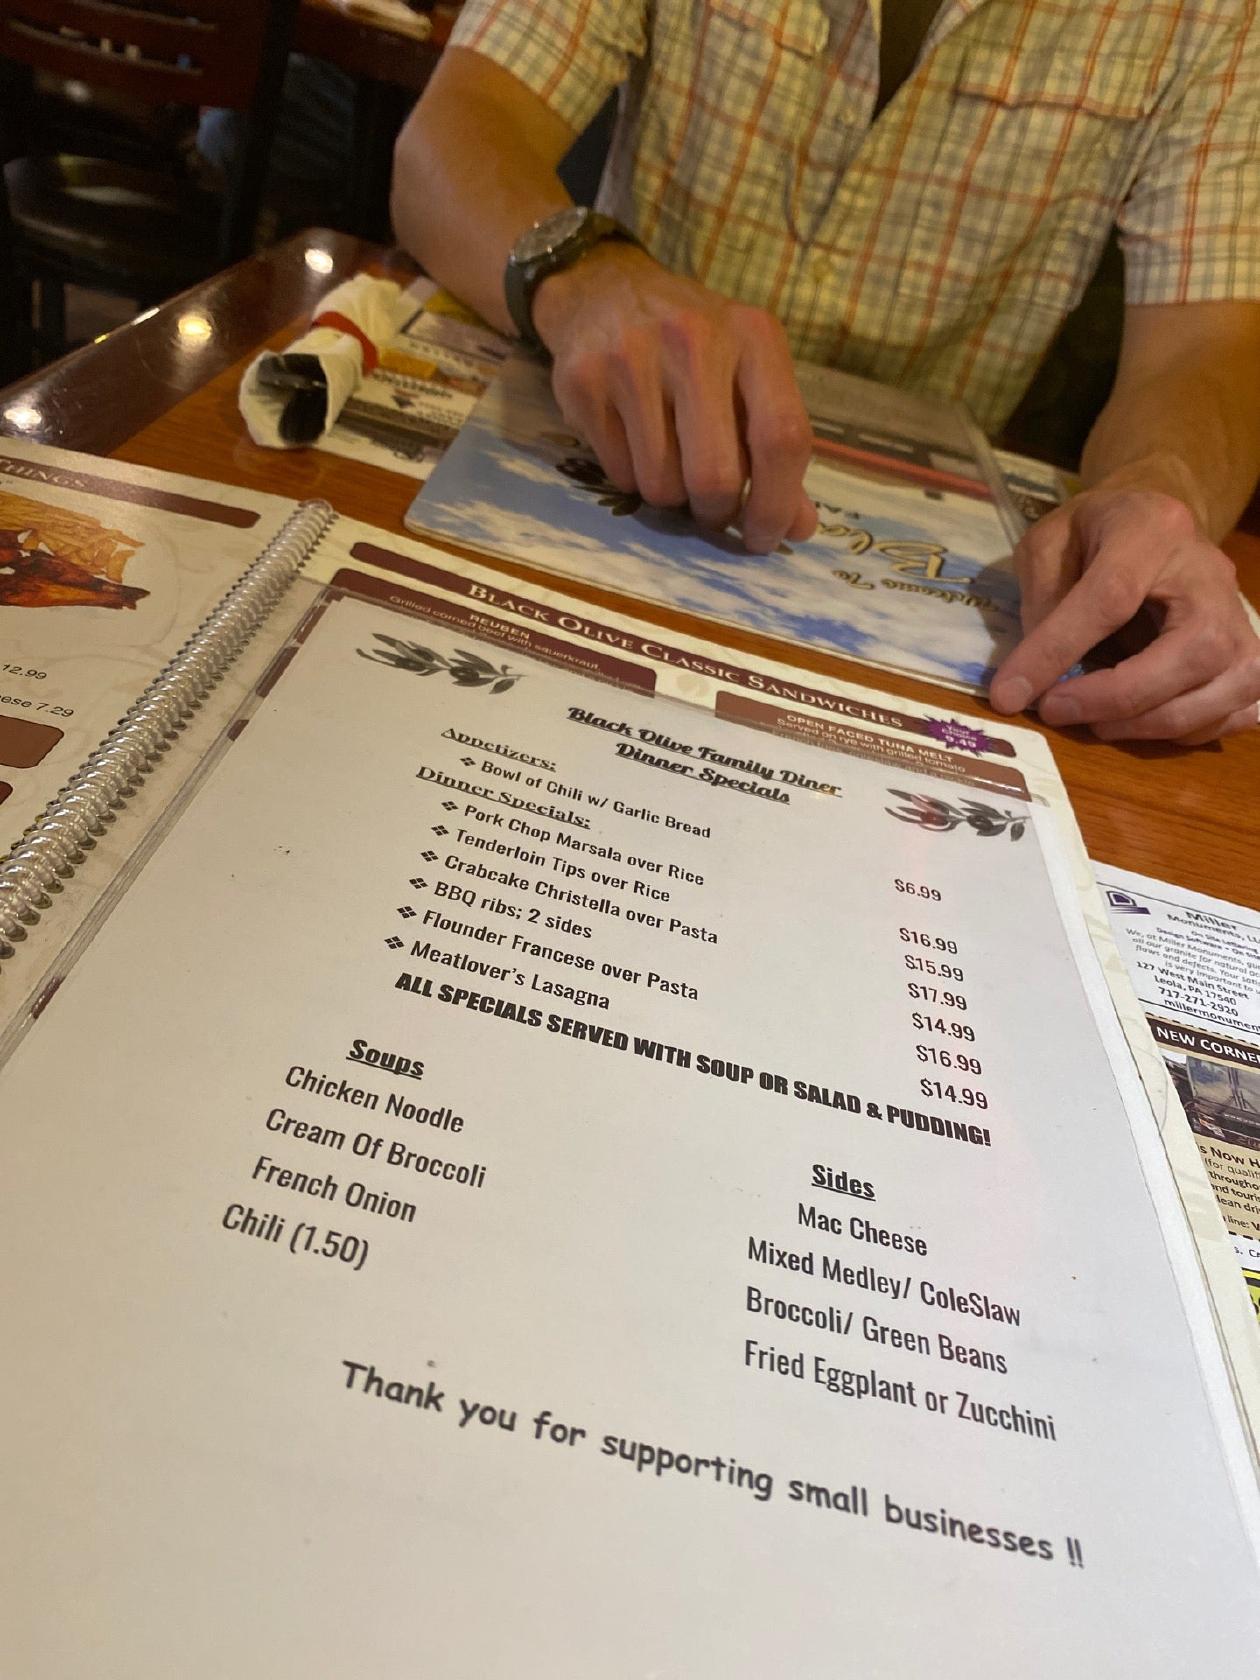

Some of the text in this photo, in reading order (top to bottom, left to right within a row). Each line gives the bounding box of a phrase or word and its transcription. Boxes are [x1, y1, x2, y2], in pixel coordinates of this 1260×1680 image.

[469, 584, 550, 622] BLACK
[558, 617, 634, 650] OLIVE
[641, 643, 740, 683] CLASSIC
[748, 674, 904, 729] SANDWICHES
[470, 614, 530, 640] REUBEN
[507, 634, 532, 648] with
[3, 664, 47, 679] 12.99
[36, 702, 75, 717] 7.29
[777, 718, 819, 736] Served
[821, 731, 837, 740] on
[859, 740, 884, 753] with
[787, 715, 825, 730] OPEN
[828, 725, 874, 743] FACED
[878, 738, 915, 753] TUNA
[918, 748, 953, 763] MELT
[441, 728, 556, 772] Appetizers:
[567, 707, 842, 797] Black Olive Family Diner
[615, 742, 791, 805] Dinner Specials
[416, 765, 592, 830] Dinner Specials:
[481, 760, 942, 902] Bowl of Chili w/ Garlic Bread $6.99
[456, 828, 964, 982] Tenderloin Tips over Rice $15.99
[464, 804, 958, 954] Pork Chop Marsala over Rice $16.99
[444, 854, 968, 1011] Crabcake Christella over Pasta $17.99
[1166, 913, 1245, 941] Monuments,
[1186, 911, 1237, 931] Miller
[434, 881, 976, 1042] BBQ ribs; 2 sides $14.99
[1136, 961, 1155, 971] 127
[1157, 967, 1185, 982] West
[1186, 975, 1216, 991] Main
[1216, 984, 1250, 1000] Street
[1146, 941, 1161, 949] our
[1164, 946, 1197, 960] granite
[1199, 954, 1212, 965] for
[1158, 936, 1185, 949] Miller
[1187, 944, 1245, 966] Monuments,
[1162, 952, 1181, 963] and
[1220, 969, 1240, 981] Your
[1175, 963, 1195, 976] very
[1196, 970, 1242, 990] important
[423, 910, 983, 1076] Flounder Francese over Pasta $16.99
[1154, 974, 1187, 992] Leola,
[1188, 984, 1203, 996] PA
[1204, 989, 1238, 1006] 17540
[1158, 986, 1239, 1017] 717-271-2920
[346, 1039, 425, 1080] Soups
[394, 972, 992, 1148] ALL SPECIALS SERVED WITH SOUP OR SALAD & PUDDING!
[531, 974, 611, 1011] Lasagna
[920, 1078, 989, 1110] $14.99
[1155, 1026, 1195, 1047] NEW
[285, 1065, 465, 1134] Chicken Noodle
[266, 1108, 487, 1188] Cream Of Broccoli
[251, 1155, 417, 1223] French Onion
[811, 1163, 876, 1202] Sides
[222, 1203, 369, 1271] Chili (1.50)
[797, 1202, 928, 1257] Mac Cheese
[748, 1236, 1021, 1327] Mixed Medley/ ColeSlaw
[746, 1285, 1008, 1375] Broccoli/ Green Beans
[744, 1338, 1058, 1442] Fried Eggplant or Zucchini
[342, 1359, 446, 1412] Thank
[458, 1398, 517, 1432] you
[533, 1410, 586, 1447] for
[600, 1433, 774, 1502] supporting
[787, 1479, 868, 1517] small
[884, 1494, 1055, 1561] businesses
